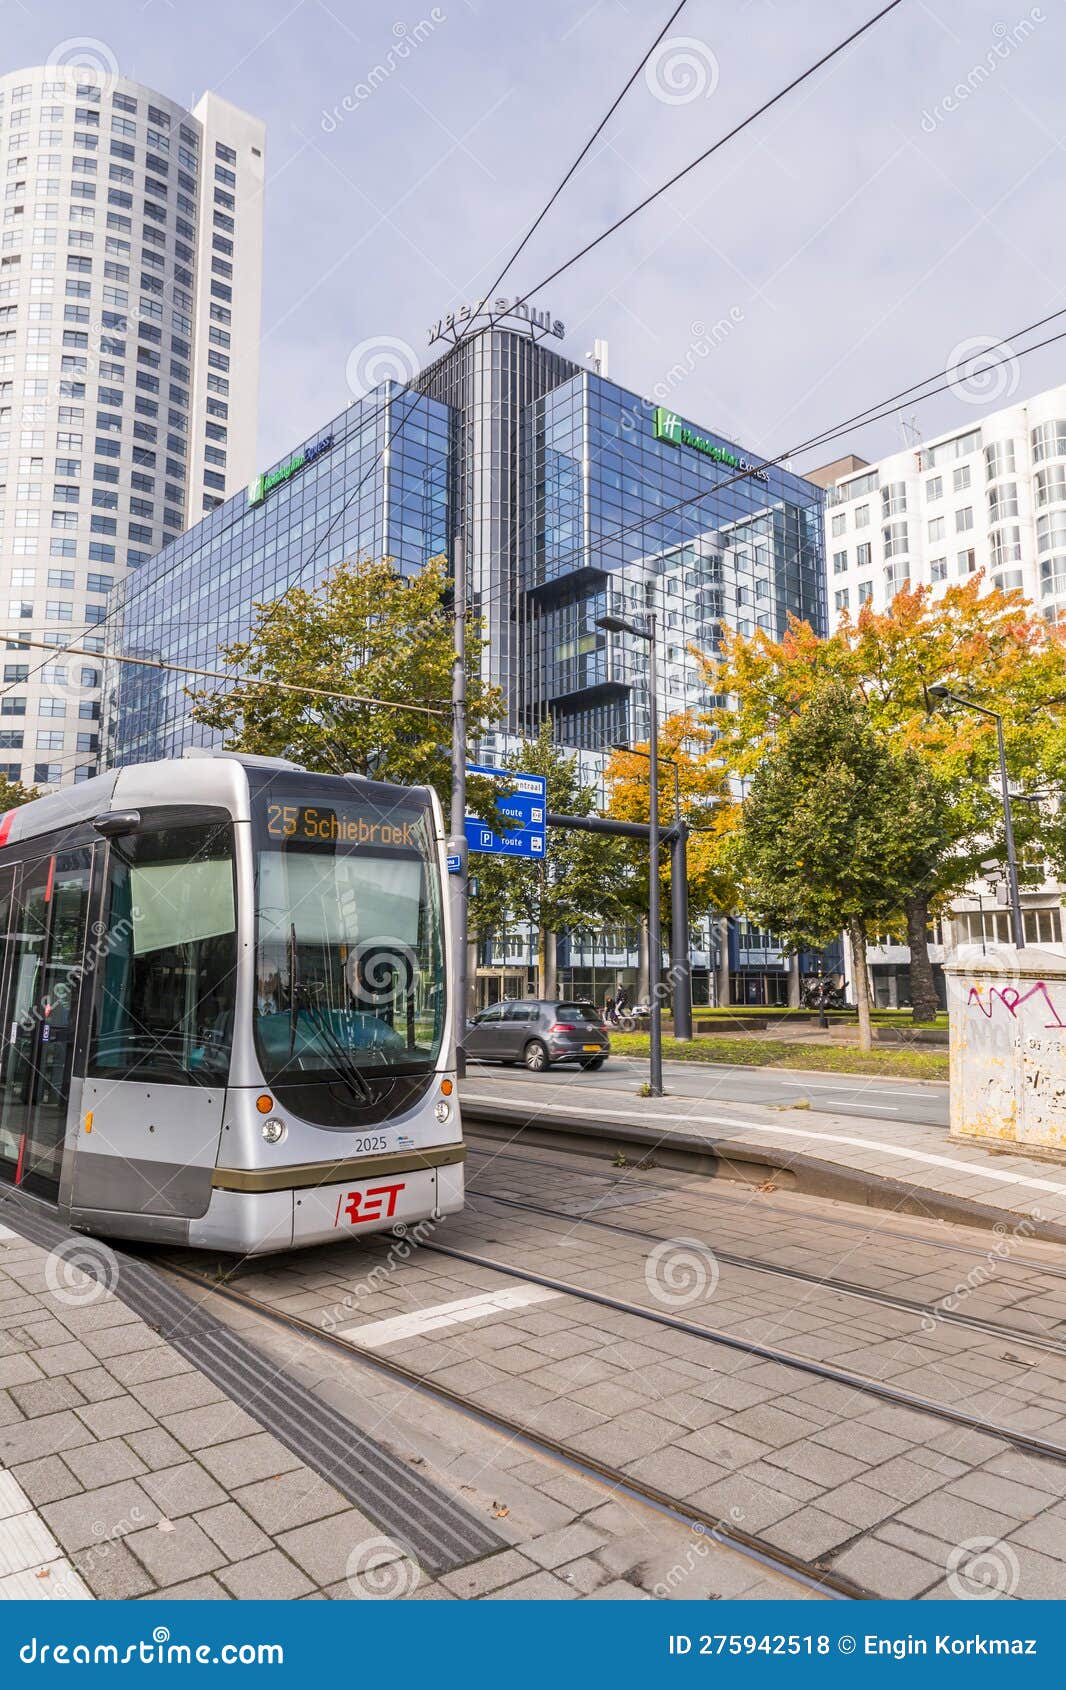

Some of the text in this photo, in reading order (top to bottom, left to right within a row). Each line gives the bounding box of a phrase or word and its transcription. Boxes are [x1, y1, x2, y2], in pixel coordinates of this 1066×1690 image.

[740, 457, 770, 481] Expess
[515, 781, 541, 792] entraal
[501, 807, 523, 818] route
[267, 805, 413, 845] 25 Schiebroek
[501, 836, 523, 847] route
[355, 1136, 388, 1153] 2025
[345, 1183, 406, 1224] RET
